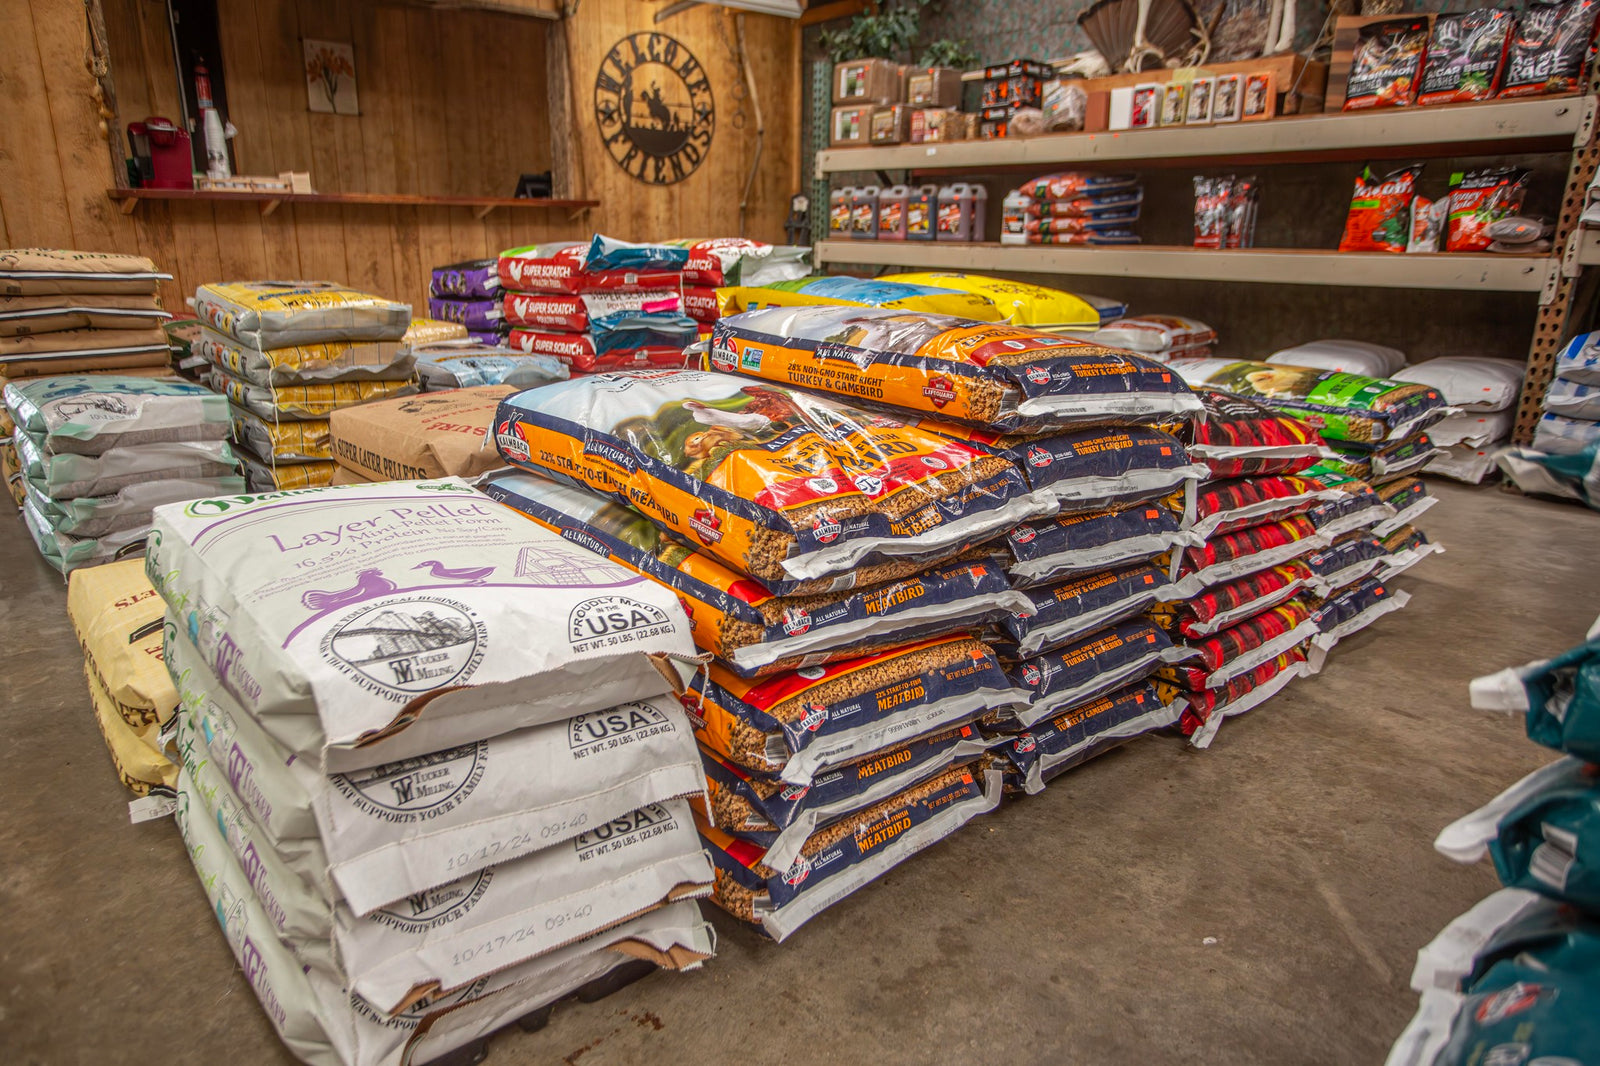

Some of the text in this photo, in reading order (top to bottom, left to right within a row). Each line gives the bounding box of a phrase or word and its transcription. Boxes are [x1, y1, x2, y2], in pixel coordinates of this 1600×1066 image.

[598, 33, 710, 96] WELCOME
[604, 125, 710, 183] FRIENDS
[523, 264, 571, 278] SUPER SCRATCH
[683, 259, 713, 271] RATCH
[528, 302, 576, 315] SUPER SCRATCH
[534, 339, 583, 356] SUPER SCRATCH
[713, 350, 737, 365] ALMBACH
[787, 362, 801, 372] 28%
[802, 364, 835, 379] NON-GMO
[836, 369, 859, 383] START
[859, 374, 883, 388] RIGHT
[787, 371, 884, 399] TURKEY & GAMEBIRD
[1074, 368, 1099, 378] TURKEY
[924, 389, 954, 400] LIFEGUARD
[498, 435, 529, 451] KALMBACH
[767, 434, 793, 451] ALL
[1076, 446, 1100, 456] TURKEY
[1105, 439, 1134, 451] GABIRD
[337, 438, 357, 459] SUPER
[359, 449, 383, 475] LAYER
[383, 457, 429, 481] PELLETS
[540, 449, 556, 465] 22%
[629, 486, 680, 527] MEABIRD
[265, 515, 382, 553] Layer
[387, 503, 492, 520] Pellet
[347, 516, 502, 543] Mini-Pellet Form
[689, 519, 720, 541] LIFEGUARD
[814, 525, 841, 541] KALMBACH
[1060, 516, 1085, 527] TURKEY
[293, 548, 357, 569] 16.5%
[360, 526, 430, 550] Protein
[576, 532, 607, 557] NATURAL
[865, 584, 925, 616] MEATBIRD
[1056, 588, 1082, 602] TURKEY
[1088, 575, 1118, 591] GAMEBIRD
[417, 595, 471, 612] BUSINESS
[815, 607, 847, 624] ALL NATURAL
[573, 597, 664, 637] PROUDLY MADE
[585, 609, 652, 635] USA
[573, 623, 676, 654] NET WT. 50 LBS. (22.68 KG.)
[327, 654, 353, 676] THAT
[413, 651, 450, 667] TUCKER
[1065, 652, 1089, 668] TURKEY
[1095, 639, 1124, 655] GAMEBIRD
[453, 648, 486, 687] FAMILY
[831, 703, 862, 718] ALL NATURAL
[877, 686, 926, 712] MEATBIRD
[585, 711, 650, 739] USA
[1056, 702, 1114, 732] TURKEY GAMEBIRD
[573, 722, 676, 760] NET WT. 50 LBS. (22.68 KG.)
[413, 767, 450, 785] TUCKER
[823, 771, 843, 783] NATURAL
[857, 749, 912, 780] MEATBIRD
[330, 739, 490, 824] THAT SUPPORTS YOUR FAMILY FAR
[594, 809, 654, 840] USA
[858, 817, 912, 854] MEATBIRD
[866, 809, 909, 837] START-TO-FINISH
[446, 812, 589, 872] 10/17/24 09:40
[578, 820, 679, 862] NET WT. 50 LBS. (22.68 KG.)
[821, 849, 843, 865] NATURAL
[368, 913, 429, 934] SUPPORTS
[429, 908, 464, 929] YOUR
[452, 926, 536, 968] 10/17/24
[545, 903, 594, 932] 09:40
